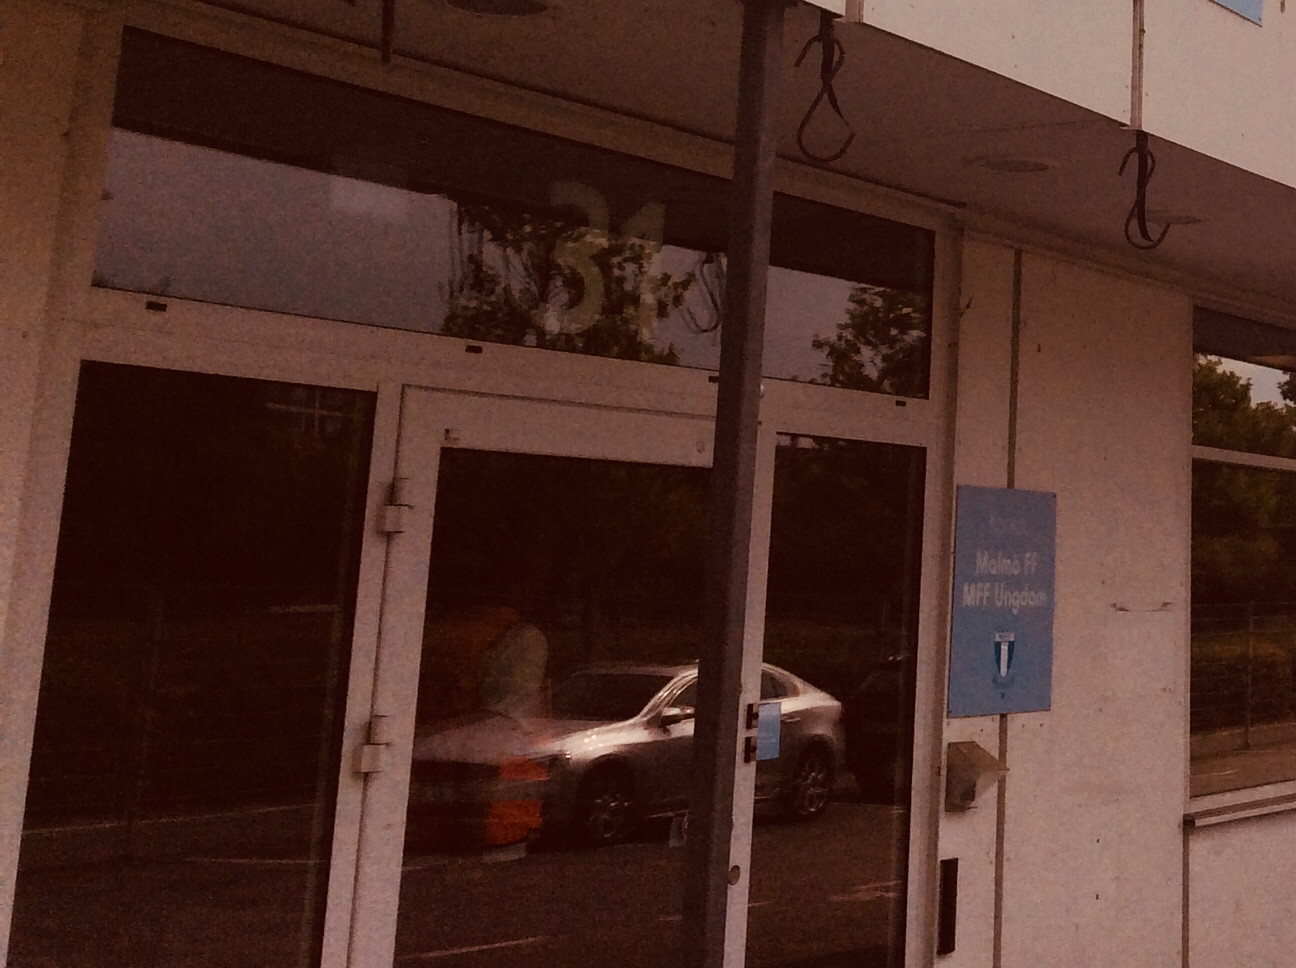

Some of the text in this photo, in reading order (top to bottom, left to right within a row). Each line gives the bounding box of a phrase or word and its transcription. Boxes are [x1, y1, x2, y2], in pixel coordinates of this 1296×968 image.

[976, 550, 1020, 575] Malmö
[963, 582, 1048, 615] MFF Ungdom
